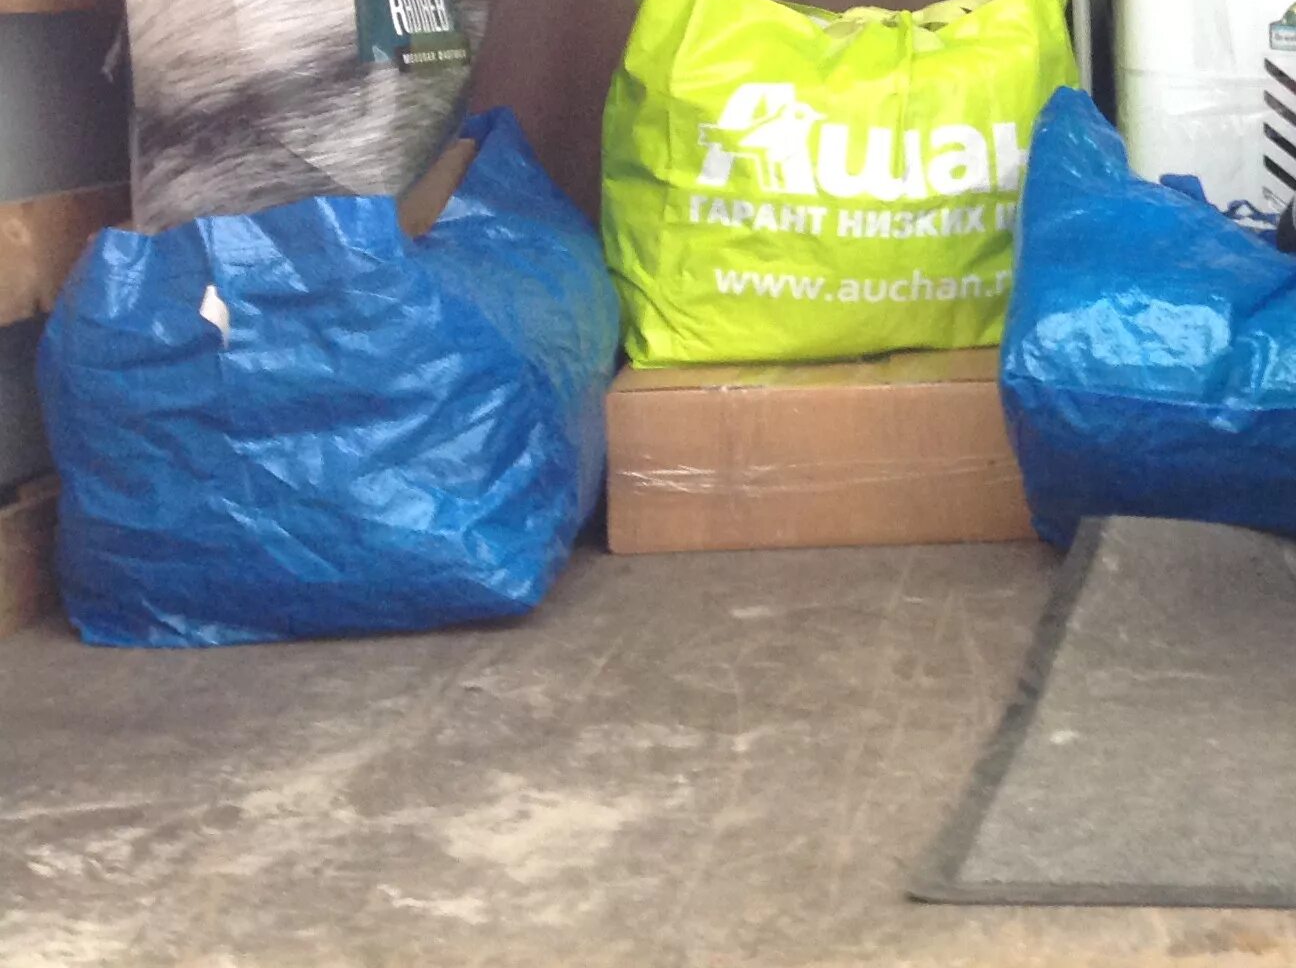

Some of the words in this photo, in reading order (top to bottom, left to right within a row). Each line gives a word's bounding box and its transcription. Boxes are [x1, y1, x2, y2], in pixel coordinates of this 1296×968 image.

[689, 195, 828, 236] ГАРАНТ
[837, 205, 986, 238] НИЗКИХ
[714, 268, 1012, 302] www.auchan.r
